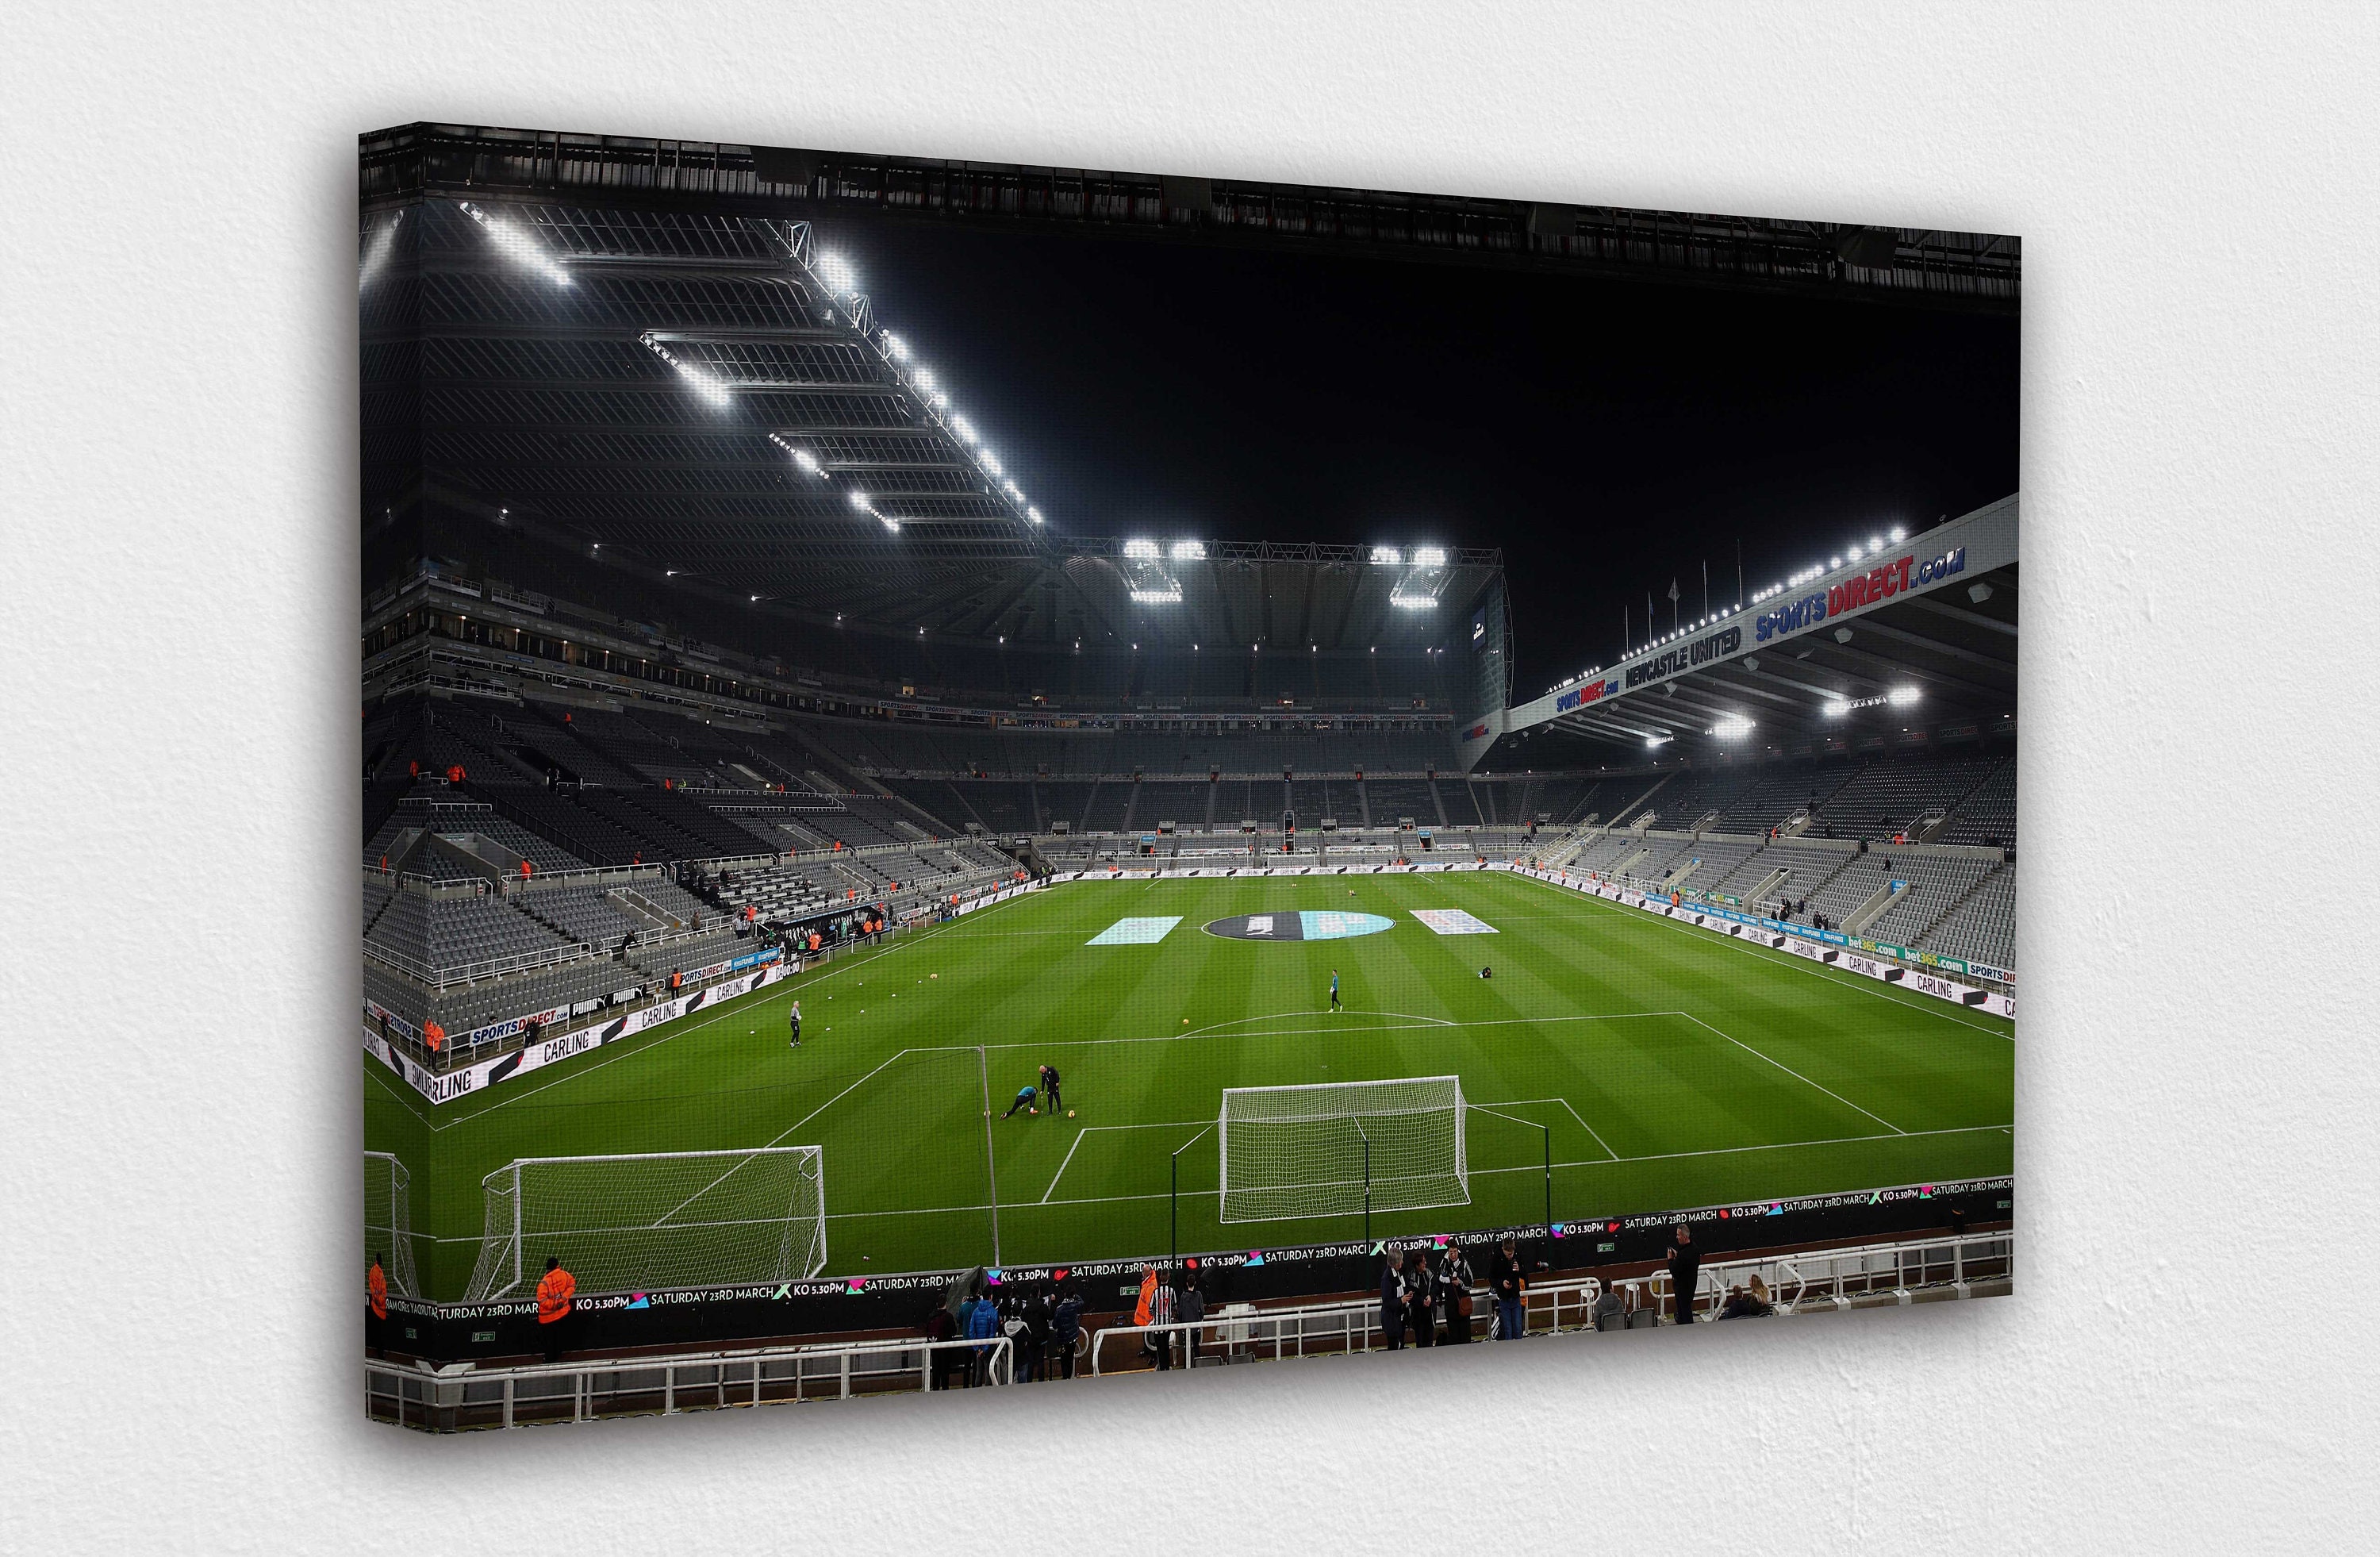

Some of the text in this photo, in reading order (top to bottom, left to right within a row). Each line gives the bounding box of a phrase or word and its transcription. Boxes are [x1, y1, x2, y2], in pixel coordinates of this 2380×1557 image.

[1626, 625, 1741, 688] NEWCASTLE UNITED
[1991, 721, 2017, 732] SPORTS
[1748, 928, 1768, 944] CARLING
[1794, 941, 1817, 958] CARLING
[1848, 936, 1897, 957] bet365.com
[783, 961, 800, 977] 00:00
[1849, 956, 1877, 975] CARLING
[1904, 950, 1963, 973] bet365.com
[717, 978, 744, 1001] CARLING
[1917, 975, 1952, 998] CARLING
[573, 987, 635, 1016] PUMA PUMA
[642, 1001, 678, 1028] CARLING
[544, 1031, 589, 1063] CARLING
[1883, 1188, 1918, 1201] KO 5.30PM
[1932, 1178, 2013, 1197] SATURDAY 23RD MARCH
[1731, 1205, 1769, 1217] KO 5.30PM
[1783, 1194, 1870, 1212] SATURDAY 23RD MARCH
[1625, 1210, 1717, 1228] SATURDAY 23RD MARCH
[1517, 1228, 1547, 1240] MARCH
[1563, 1222, 1604, 1235] KO 5.30PM
[1388, 1239, 1431, 1251] KO 5.30PM
[1201, 1254, 1247, 1268] KO 5.30PM
[1265, 1249, 1315, 1263] SATURDAY
[1315, 1247, 1337, 1259] 23RD
[1018, 1269, 1049, 1281] 5.30PM
[1072, 1264, 1123, 1277] SATURDAY
[1124, 1262, 1146, 1274] 23RD
[793, 1282, 845, 1296] KO 5.30PM
[865, 1278, 919, 1291] SATURDAY
[920, 1276, 943, 1288] 23RD
[576, 1296, 630, 1310] KO 5.30PM
[651, 1286, 774, 1305] SATURDAY 23RD MARCH
[487, 1305, 512, 1317] 23RD
[515, 1302, 539, 1314] MAR
[1158, 1298, 1170, 1315] 17
